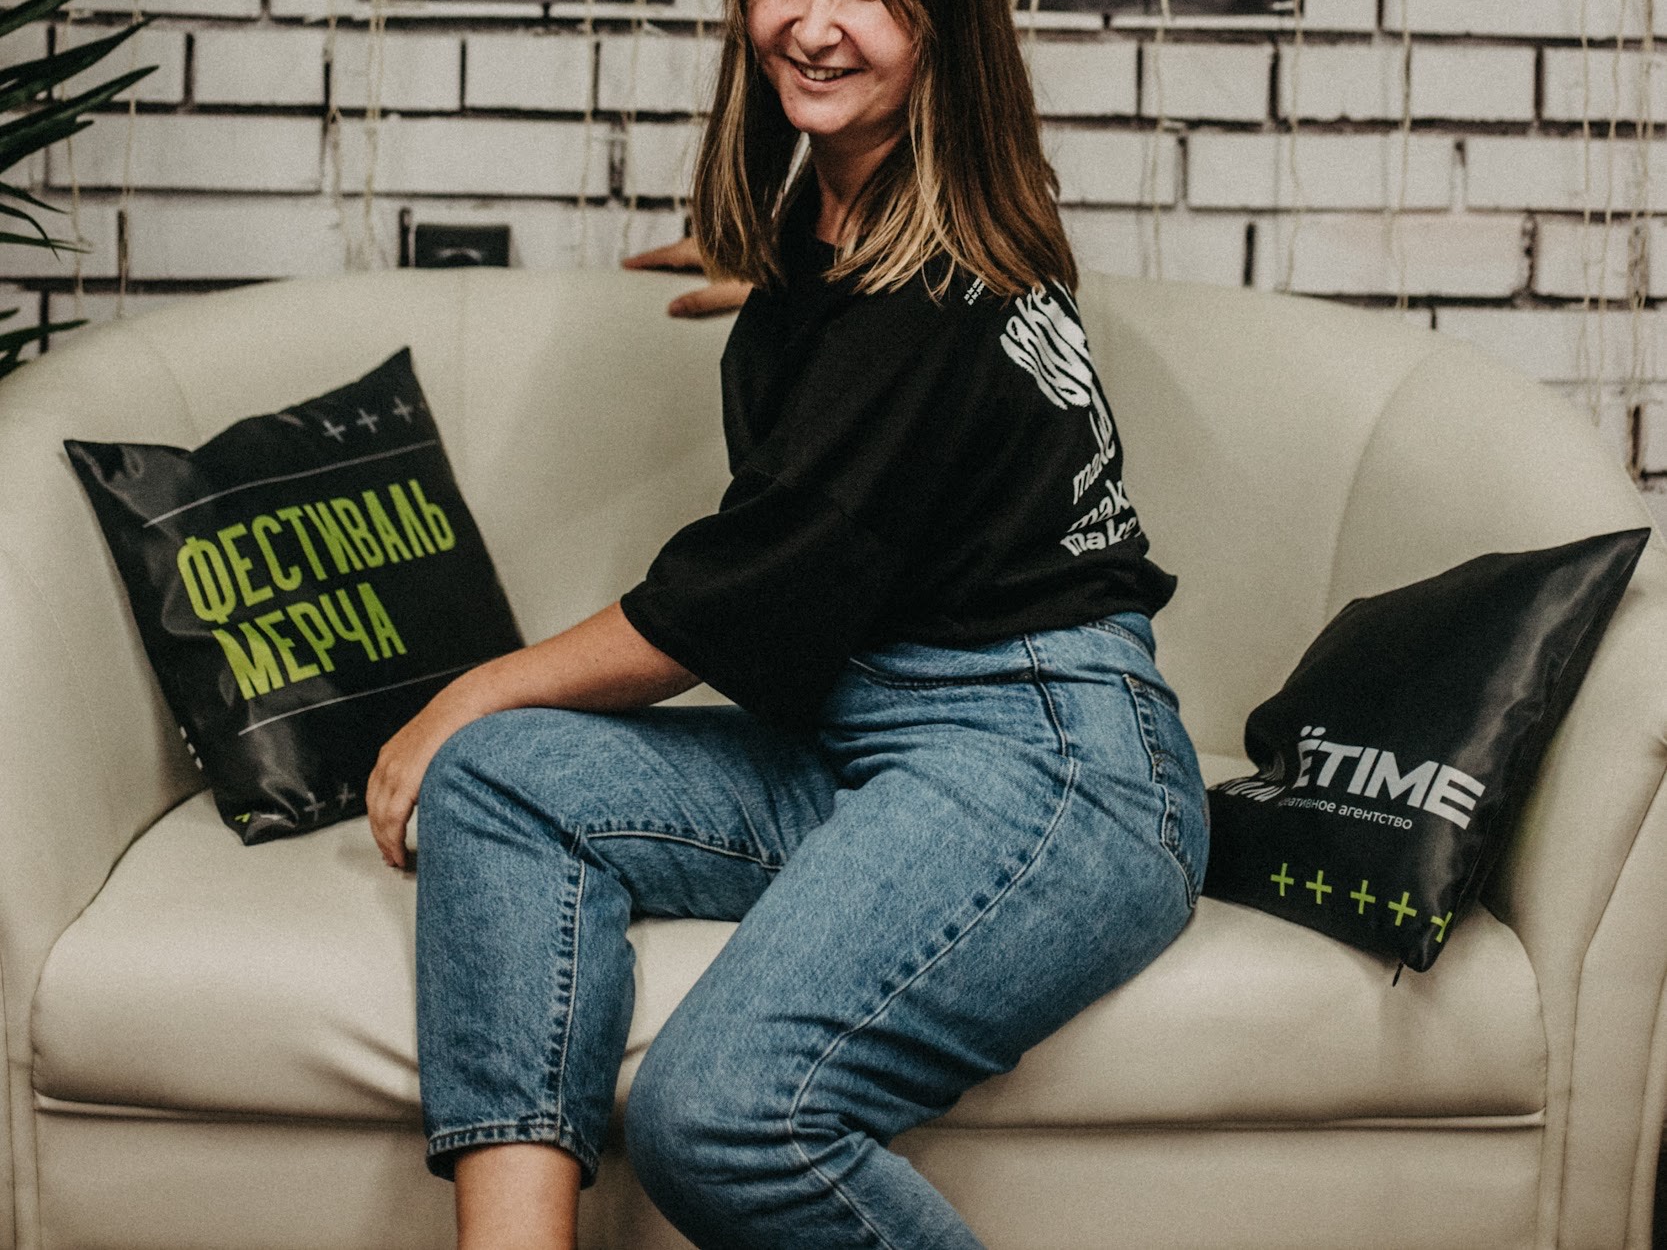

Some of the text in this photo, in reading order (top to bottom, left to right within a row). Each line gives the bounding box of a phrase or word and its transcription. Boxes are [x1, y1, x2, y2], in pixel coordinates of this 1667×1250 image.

[176, 478, 457, 625] ФЕСТИВАЛЬ
[212, 582, 408, 701] МЕРЧА
[1338, 804, 1413, 831] агентство
